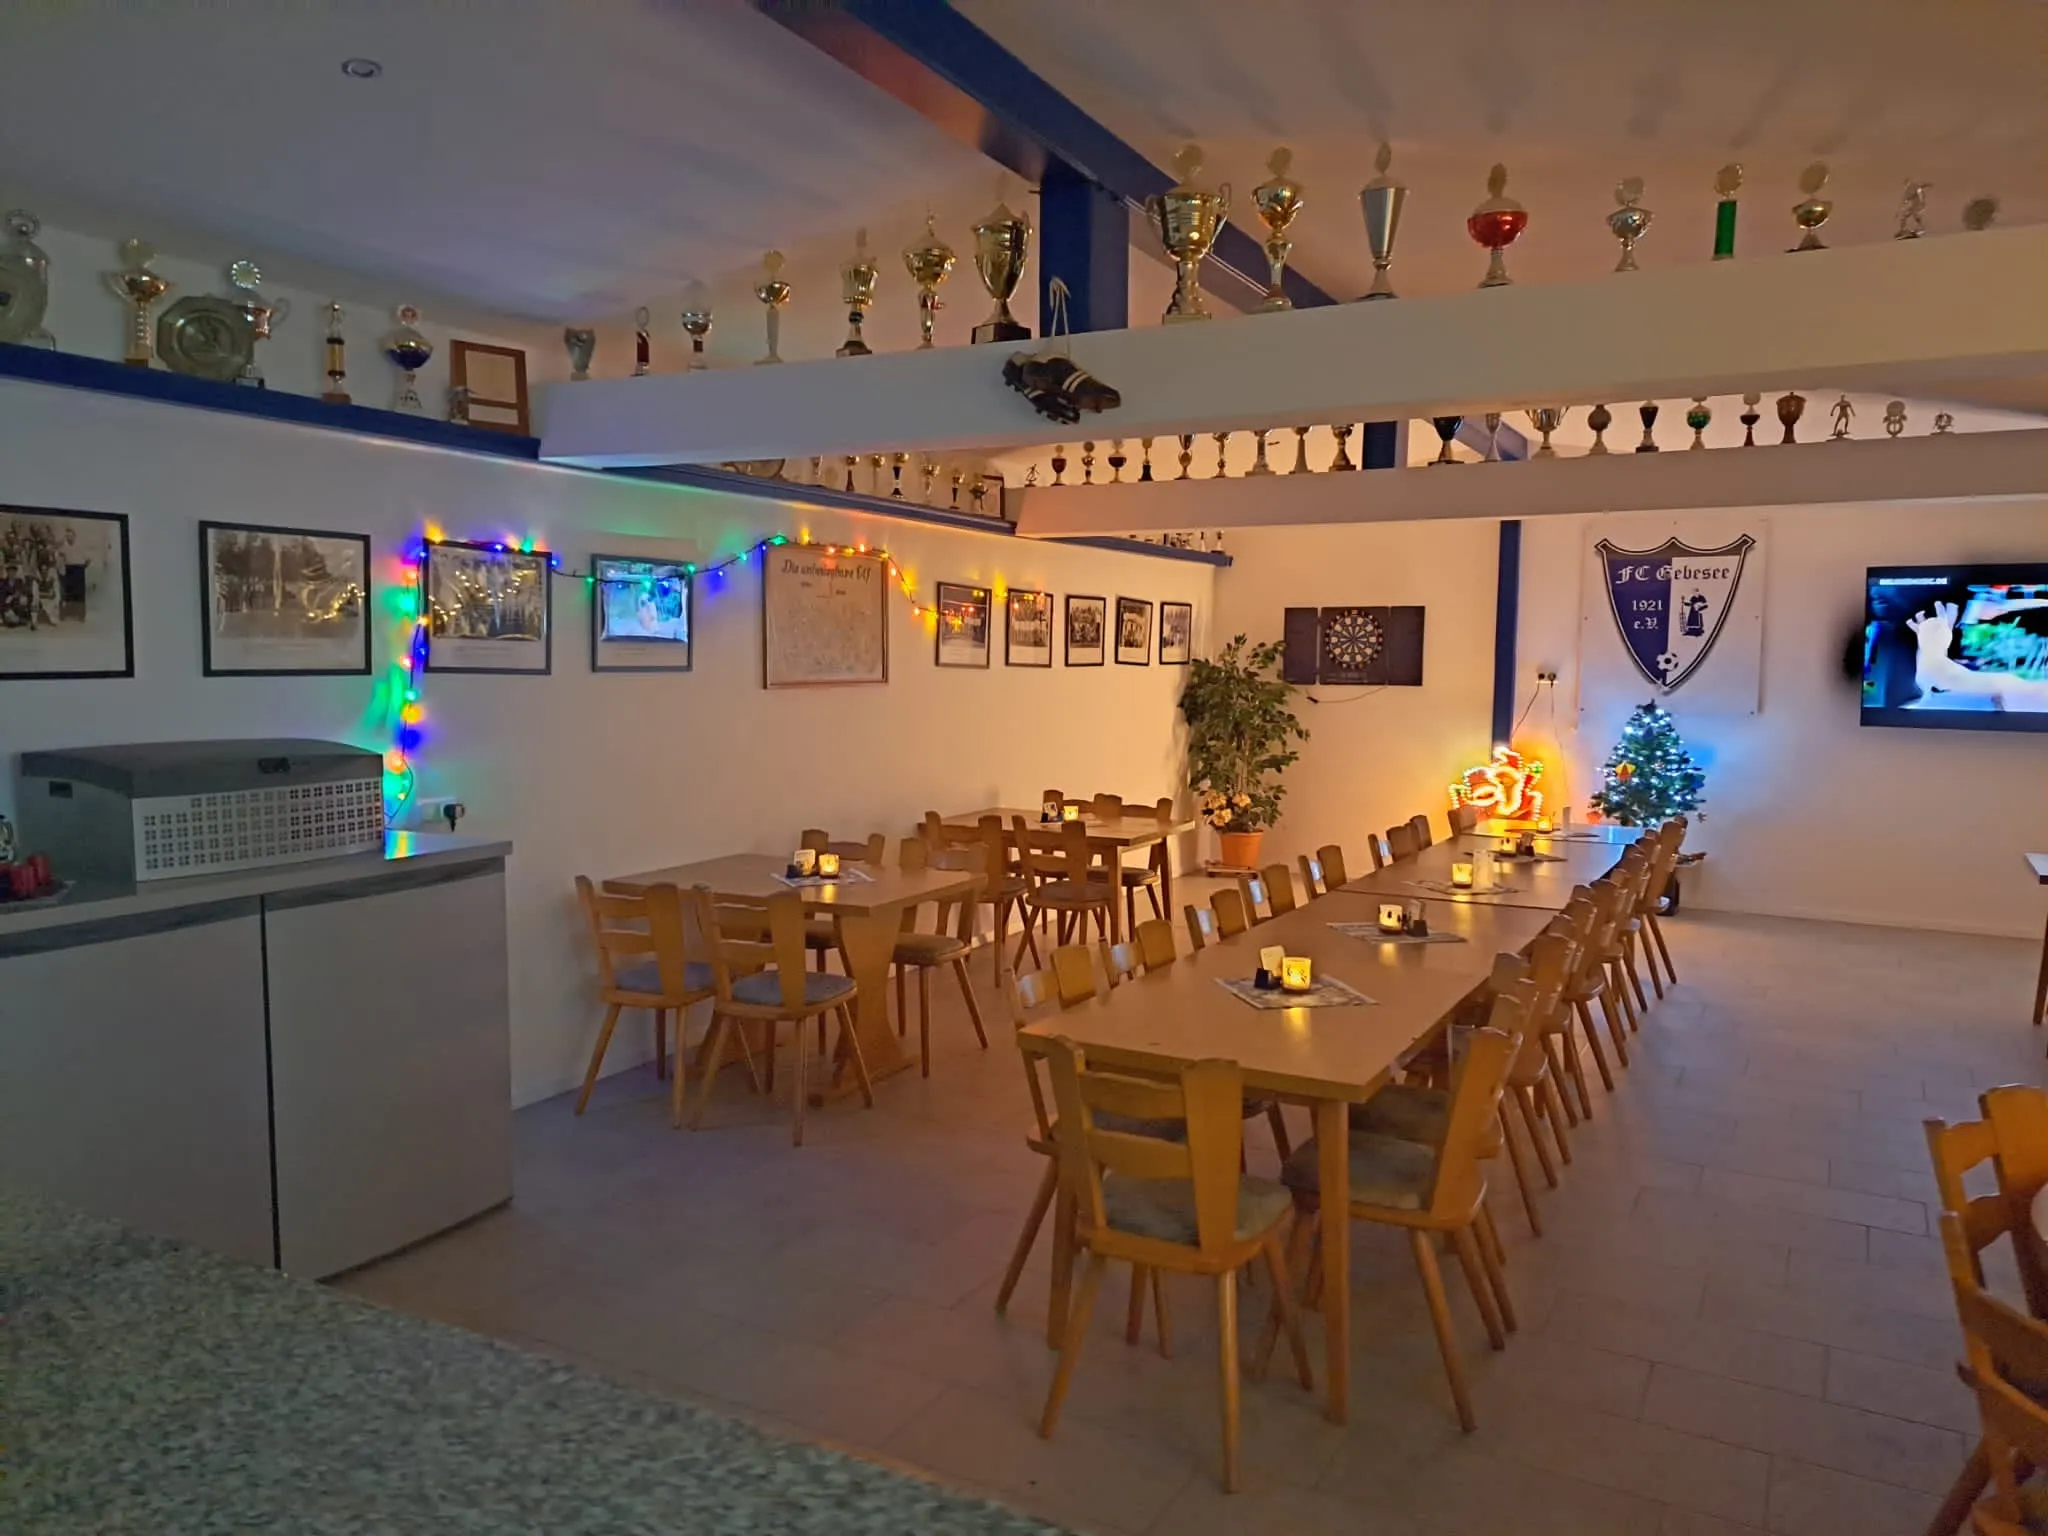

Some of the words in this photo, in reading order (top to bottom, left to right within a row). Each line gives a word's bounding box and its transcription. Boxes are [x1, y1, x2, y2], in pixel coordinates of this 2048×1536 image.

[1615, 565, 1650, 584] FC
[1656, 564, 1731, 581] Gebesee
[1632, 599, 1663, 611] 1921
[1633, 617, 1659, 630] e.V.
